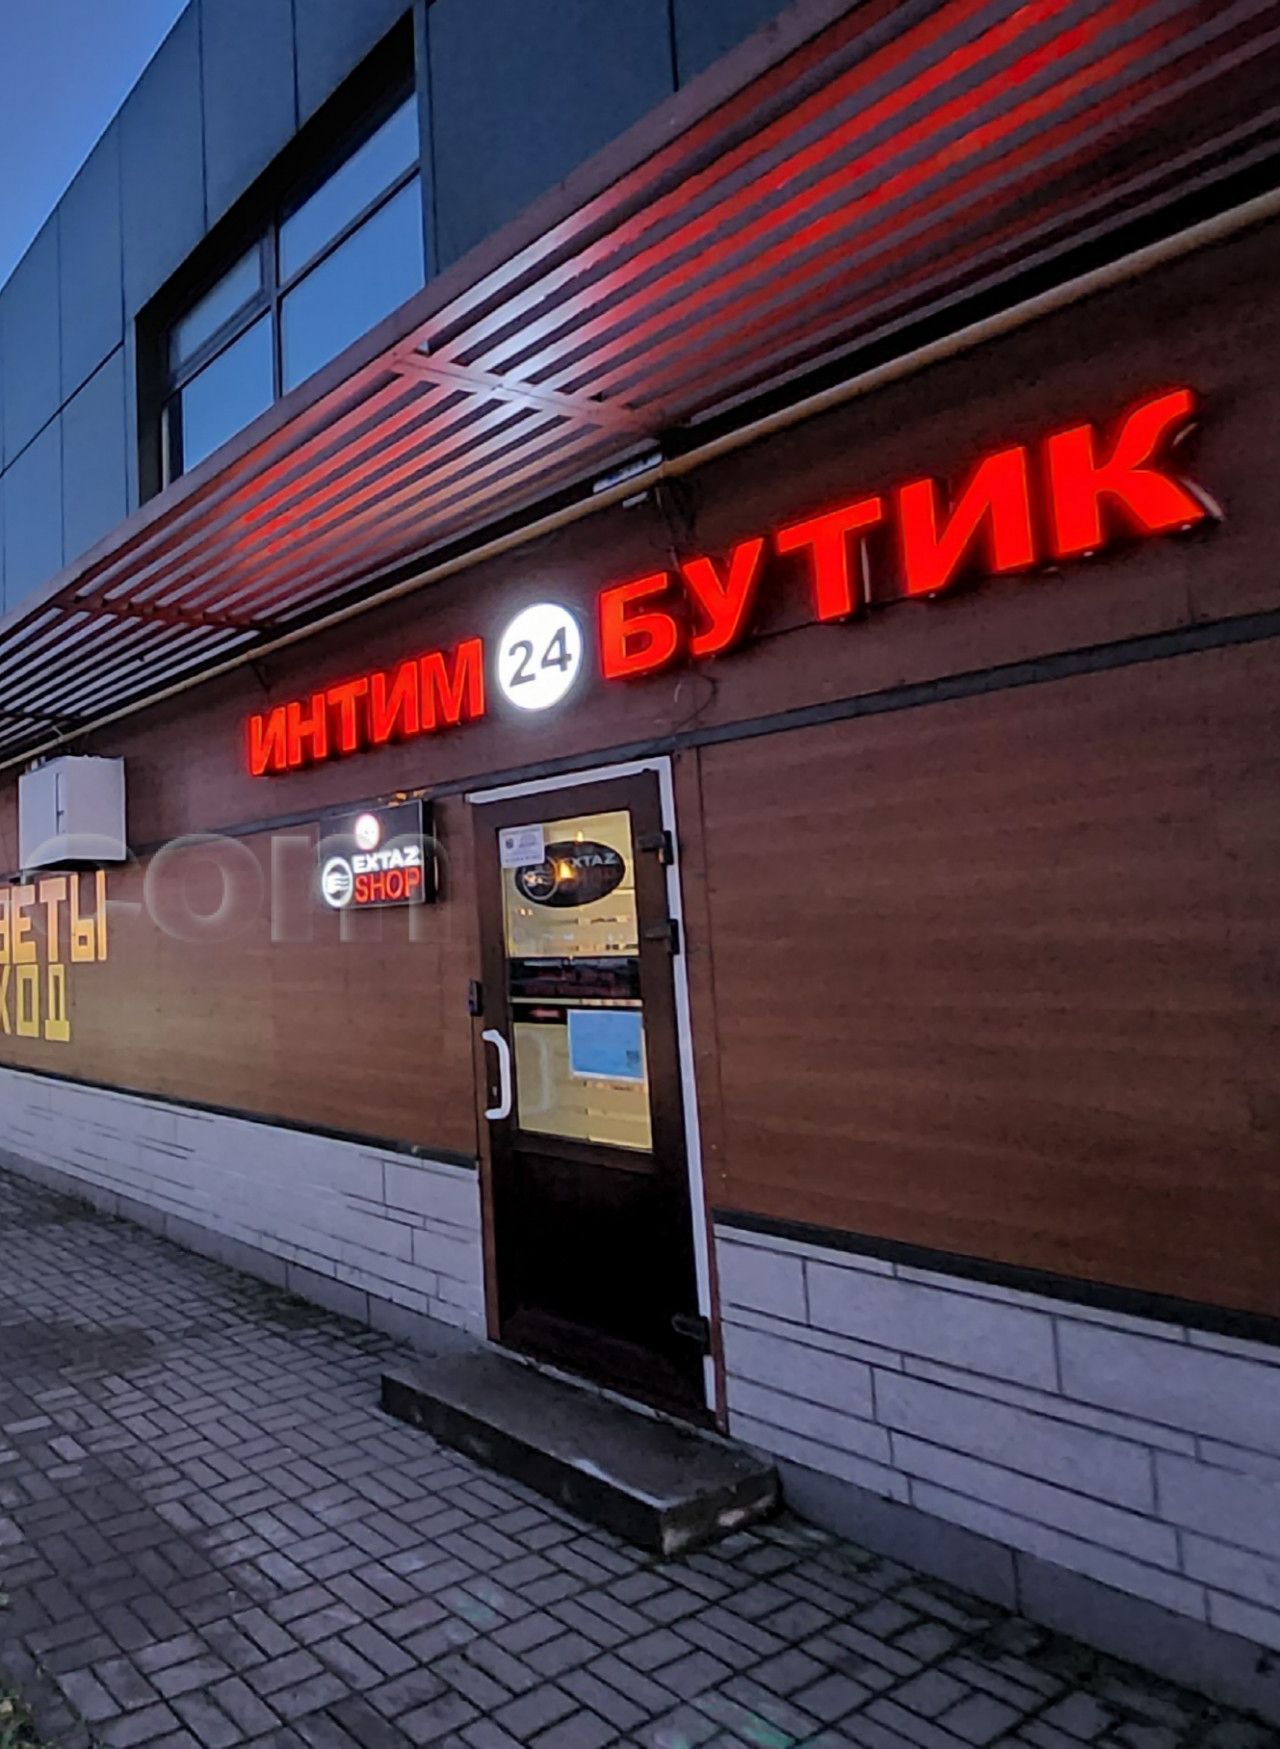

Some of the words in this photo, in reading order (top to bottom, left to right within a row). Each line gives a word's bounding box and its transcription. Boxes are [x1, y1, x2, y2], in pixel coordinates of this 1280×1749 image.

[245, 638, 486, 777] ИНТИМ
[508, 626, 572, 688] 24
[599, 389, 1204, 680] БУТИК
[351, 844, 421, 874] EXTAZ
[558, 852, 621, 868] XTAZ
[354, 866, 422, 904] SHOP
